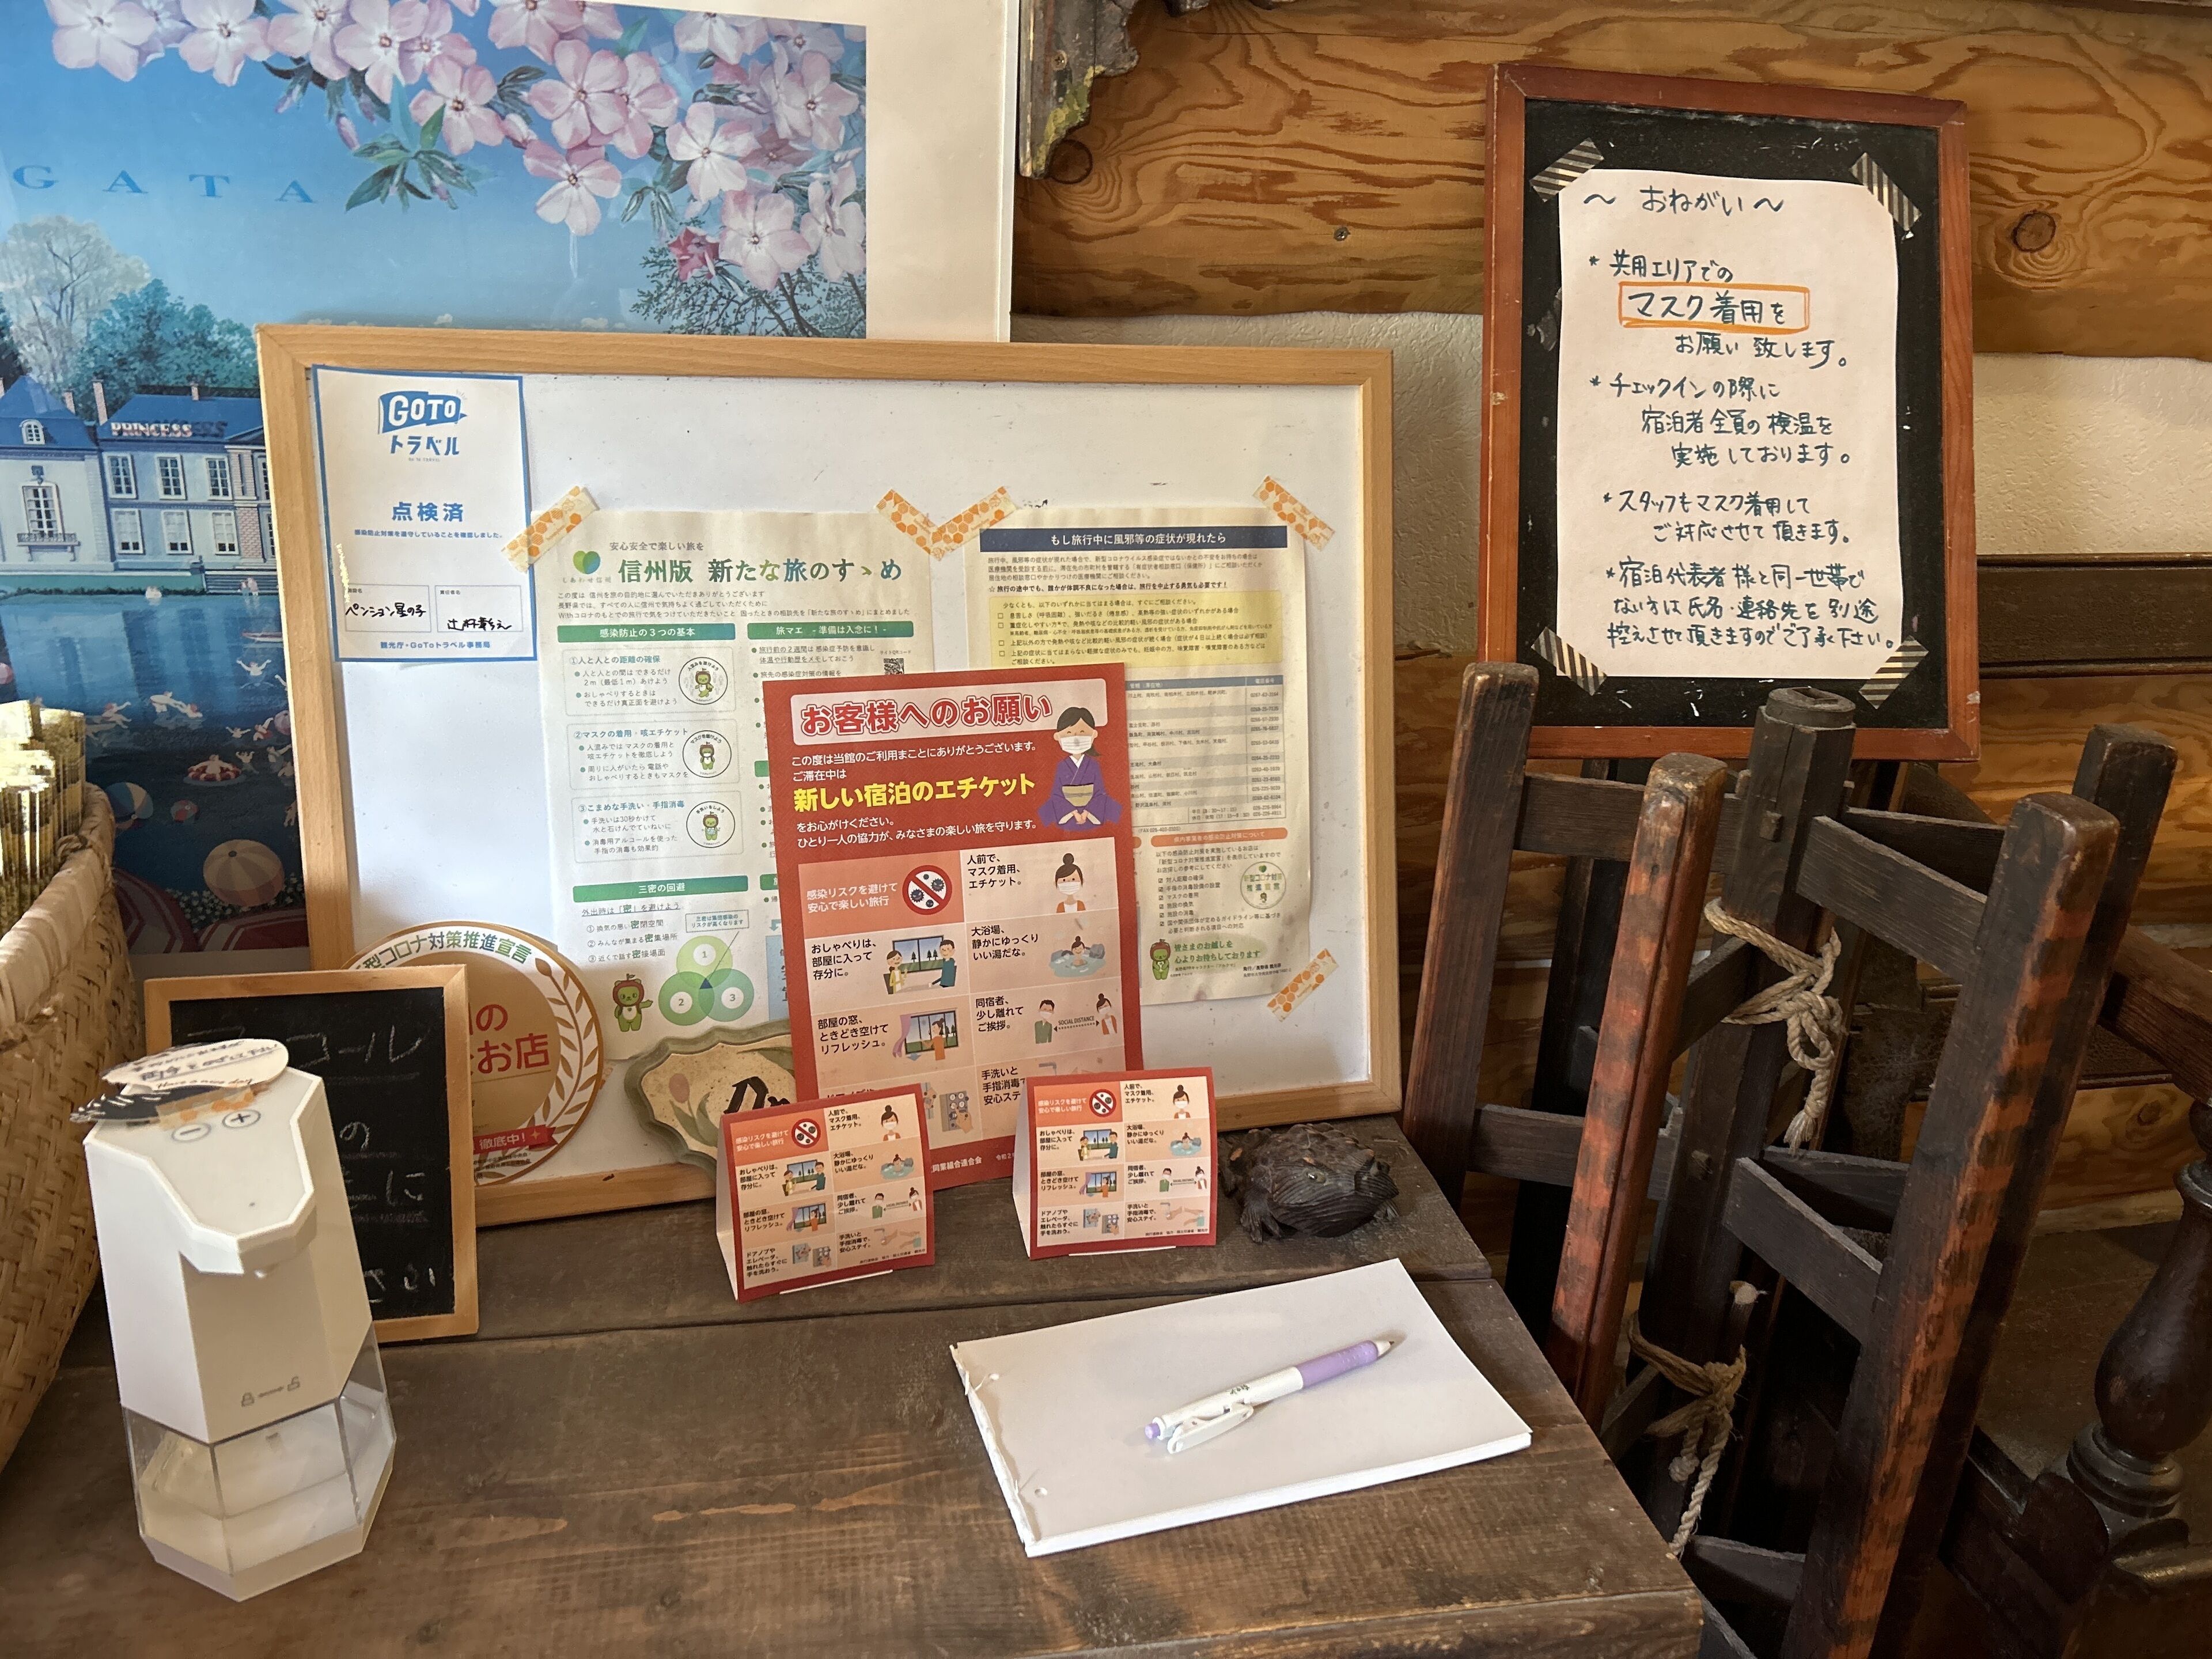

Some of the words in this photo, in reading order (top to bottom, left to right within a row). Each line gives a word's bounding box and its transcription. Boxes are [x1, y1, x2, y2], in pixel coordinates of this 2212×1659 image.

[1609, 248, 1734, 283] 共用エリアでの
[1628, 291, 1786, 325] マスク着用を
[1609, 372, 1781, 402] チェックインの際に
[1641, 406, 1833, 435] 宿泊者全員の検温を
[111, 422, 194, 438] PRINCESS
[391, 435, 460, 456] トラベル
[392, 501, 464, 522] 点検済
[1619, 491, 1812, 516] スタッフもマスク着用して
[1051, 533, 1226, 546] もし旅行中に風邪等の症状が現れたら
[1653, 520, 1850, 545] ご対応させて頂きます。
[610, 541, 704, 551] 安心安全で楽しい旅を
[618, 559, 693, 583] 信州版
[1619, 555, 1865, 590] 宿泊代表者様と同一世帯で
[345, 602, 426, 618] ペンション星の子
[600, 628, 696, 638] 感染防止の3つの基本
[776, 626, 802, 635] 旅マエ
[801, 693, 1053, 736] お客様へのお願い
[791, 741, 1036, 767] この度は当館のご利用まことにありがとうございます。
[793, 769, 847, 782] ご滞在中は
[793, 773, 1035, 813] 新しい宿泊のエチケット
[796, 817, 895, 832] をお心がけください。
[797, 819, 1036, 848] ひとり一人の協力が、みなさまの楽しい旅を守ります。
[967, 853, 1001, 865] 人前で、
[968, 864, 1021, 877] マスク着用、
[638, 882, 685, 893] 三密の回避
[806, 882, 898, 900] 感染リスクを避けて
[968, 877, 1022, 889] エチケット。
[807, 895, 889, 914] 安心で楽しい旅行
[971, 925, 1005, 937] 大浴場、
[811, 938, 876, 955] おしゃべりは、
[972, 933, 1039, 950] 静かにゆっくり
[356, 930, 532, 970] 型コロナ対策推進宣言
[973, 947, 1028, 961] いい湯だな。
[1175, 950, 1260, 964] 心よりお待ちしております
[812, 951, 872, 967] 部屋に入って
[813, 968, 849, 980] 存分に。
[679, 998, 684, 1006] 2
[729, 994, 736, 1002] 3
[975, 997, 1009, 1009] 同宿者、
[976, 1006, 1024, 1020] 少し離れて
[817, 1014, 863, 1029] 部屋の窓、
[978, 1020, 1012, 1033] ご挨拶。
[820, 1023, 888, 1043] ときどき空けて
[469, 1033, 550, 1075] お店
[821, 1040, 887, 1055] リフレッシュ。
[982, 1066, 1018, 1080] 手洗いと
